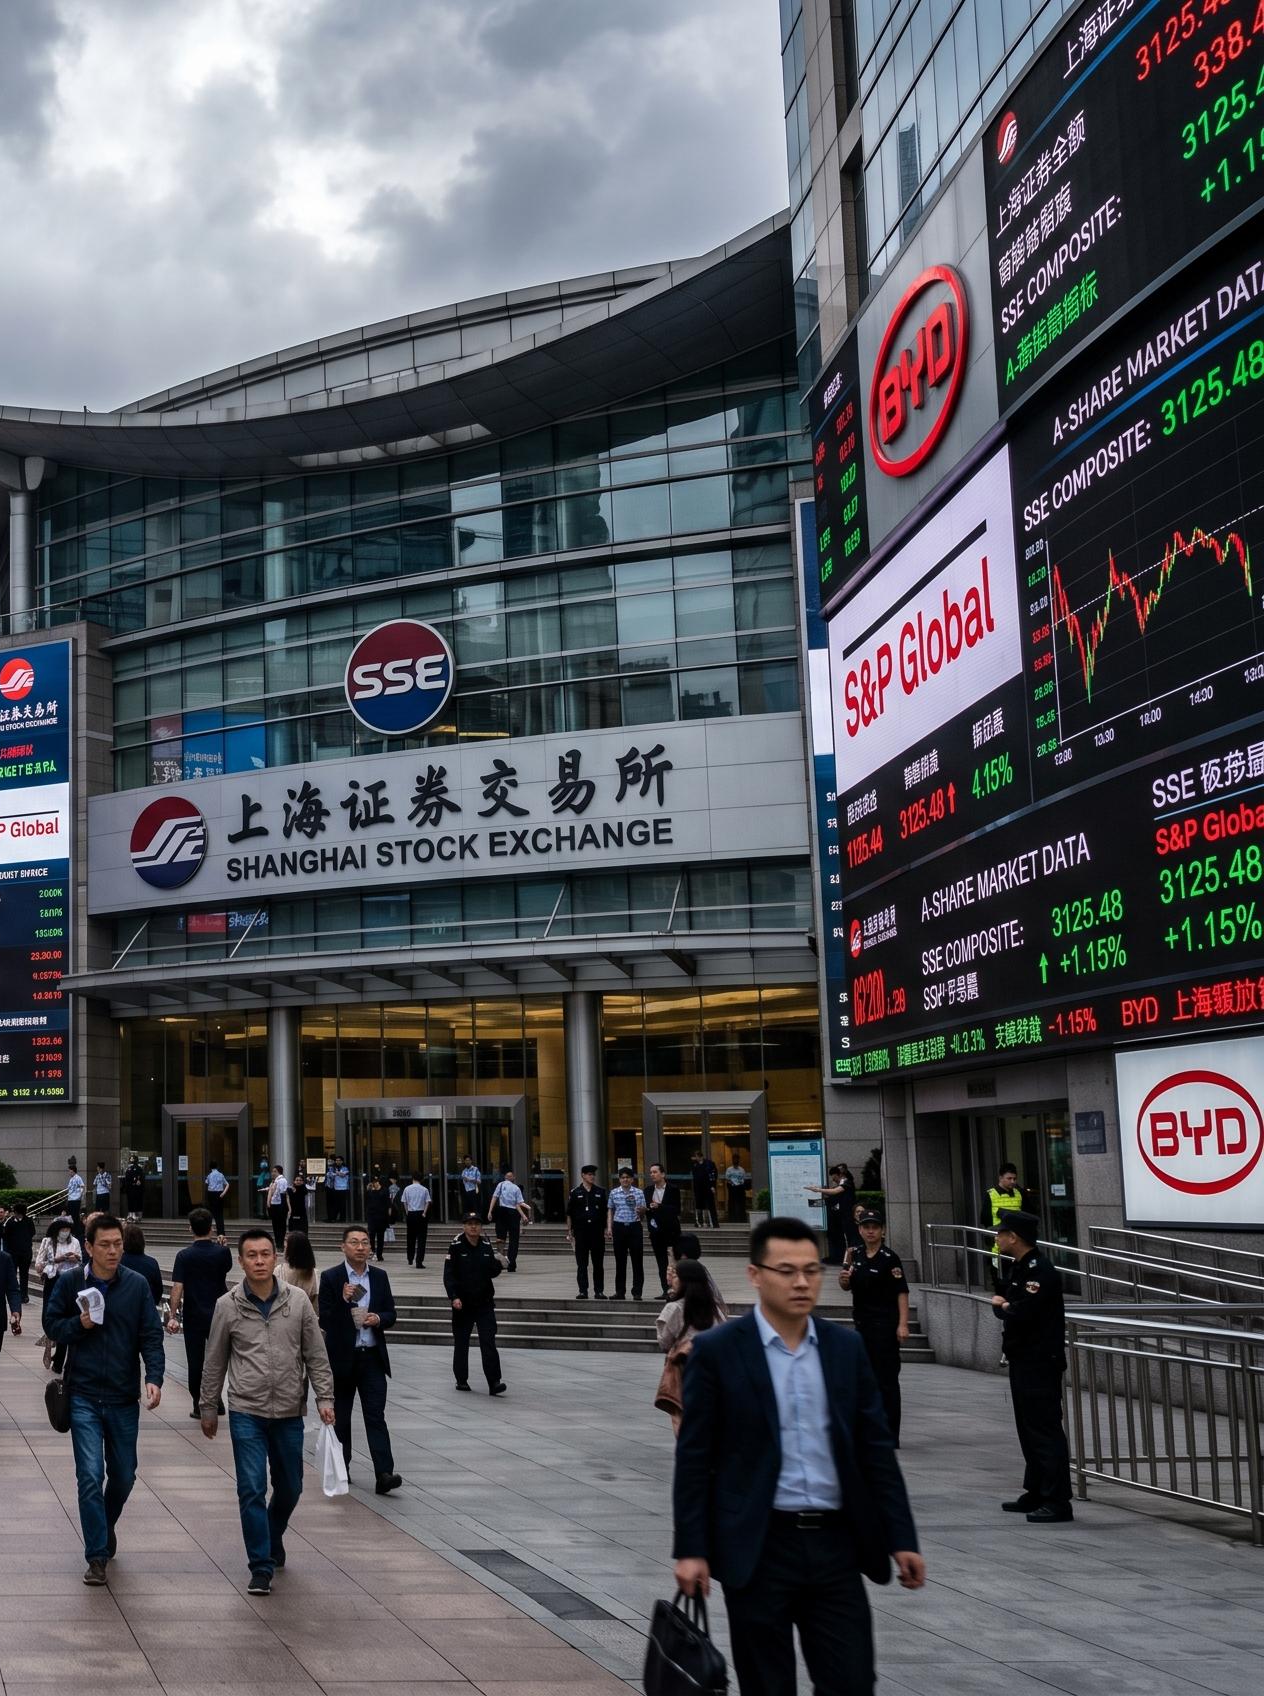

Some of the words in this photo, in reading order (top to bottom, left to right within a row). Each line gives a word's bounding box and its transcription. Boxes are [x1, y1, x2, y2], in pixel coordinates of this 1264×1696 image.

[1001, 289, 1025, 334] SSE
[1027, 194, 1122, 305] COMPOSITE:
[879, 301, 955, 446] BYD
[1053, 365, 1124, 446] A-SHARE
[1127, 298, 1211, 385] MARKET
[1217, 261, 1264, 320] DAT
[1023, 491, 1051, 532] SSE
[1052, 418, 1152, 510] COMPOSITE:
[1160, 339, 1264, 437] 3125.48
[844, 641, 893, 738] S&P
[898, 556, 995, 695] Global
[352, 653, 447, 700] SSE
[227, 744, 673, 844] 上海证券交易所
[971, 752, 1013, 800] 4.15%
[1152, 767, 1196, 808] SSE
[10, 817, 59, 838] Global
[899, 788, 945, 840] 3125.48
[1156, 818, 1198, 855] S&P
[226, 844, 367, 882] SHANGHAI
[376, 833, 481, 867] STOCK
[489, 817, 674, 857] EXCHANGE
[1160, 845, 1263, 904] 3125.48
[921, 876, 974, 923] A-SHARE
[977, 849, 1039, 901] MARKET
[1042, 832, 1091, 876] DATA
[1051, 889, 1124, 938] 3125.48
[1164, 902, 1262, 952] +1.15%
[922, 947, 944, 976] SSE
[945, 919, 1025, 971] COMPOSITE:
[1060, 934, 1128, 977] +1.15%
[1048, 1006, 1098, 1036] -1.15%
[1121, 997, 1159, 1027] BYD
[1149, 1106, 1249, 1158] BYD
